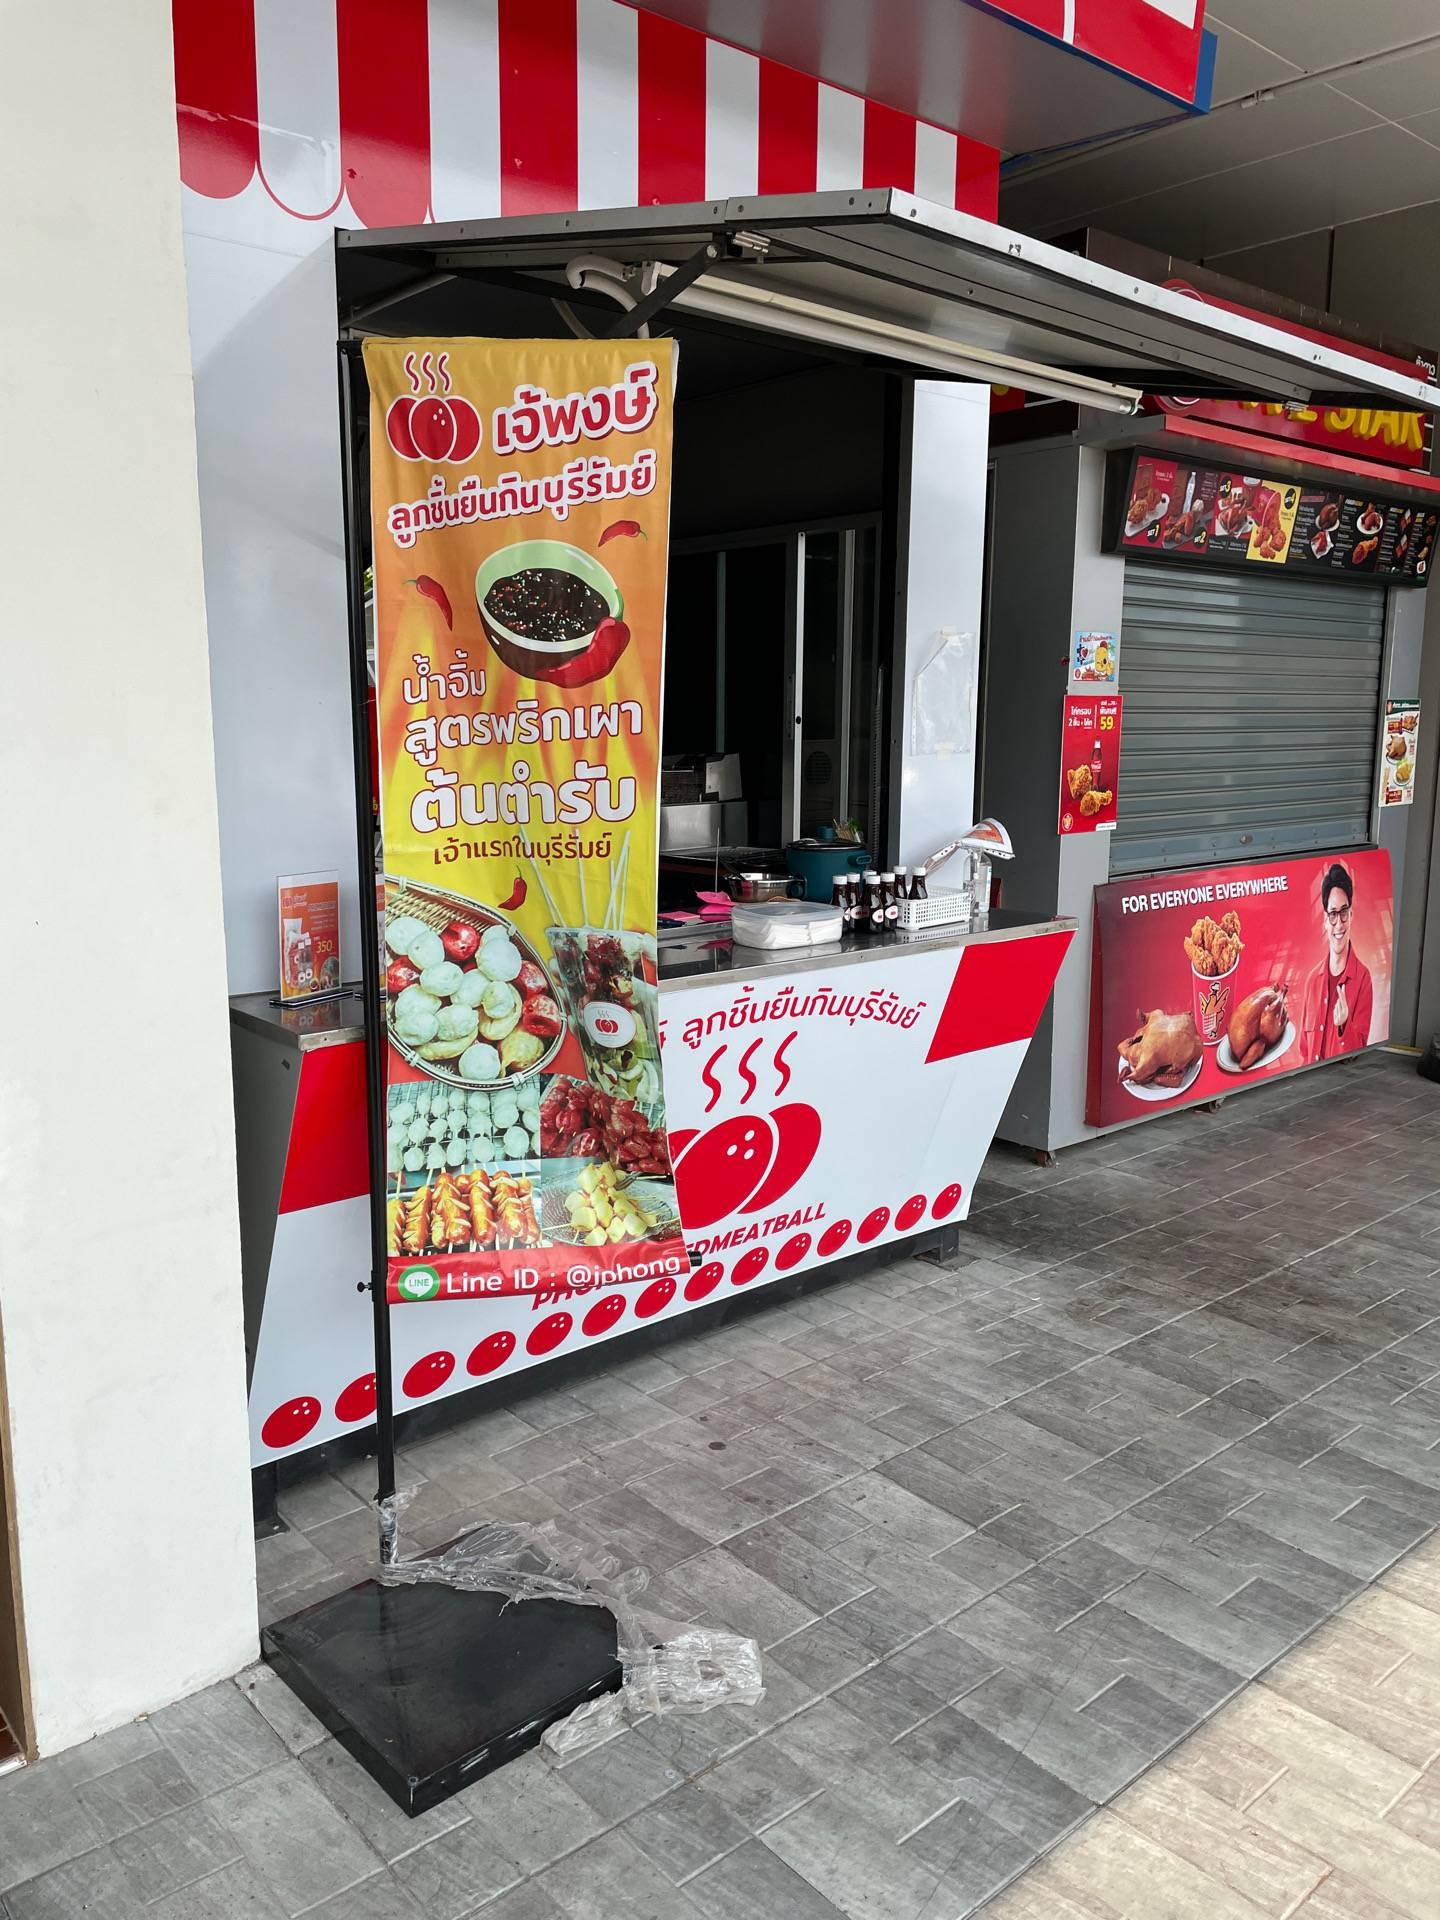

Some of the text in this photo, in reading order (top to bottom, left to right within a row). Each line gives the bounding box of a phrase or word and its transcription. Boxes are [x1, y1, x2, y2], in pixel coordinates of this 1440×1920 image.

[388, 451, 655, 546] ลูกชิ้นยืนกินบุรีรัมย์
[402, 649, 487, 705] น้ำจิ้ม
[404, 699, 642, 767] สูตรพริกเผา
[410, 759, 637, 834] ต้นตำรับ
[433, 831, 613, 866] เจ้าแรกในบุรีรัมย์
[1121, 875, 1289, 914] FOR EVERYONE EVERYWHERE
[681, 985, 928, 1050] ลูกชิ้นยืนกินบุรีรัมย์
[408, 1277, 431, 1288] LINE
[446, 1271, 503, 1294] Line
[513, 1267, 540, 1291] ID
[566, 1255, 681, 1289] @jphong
